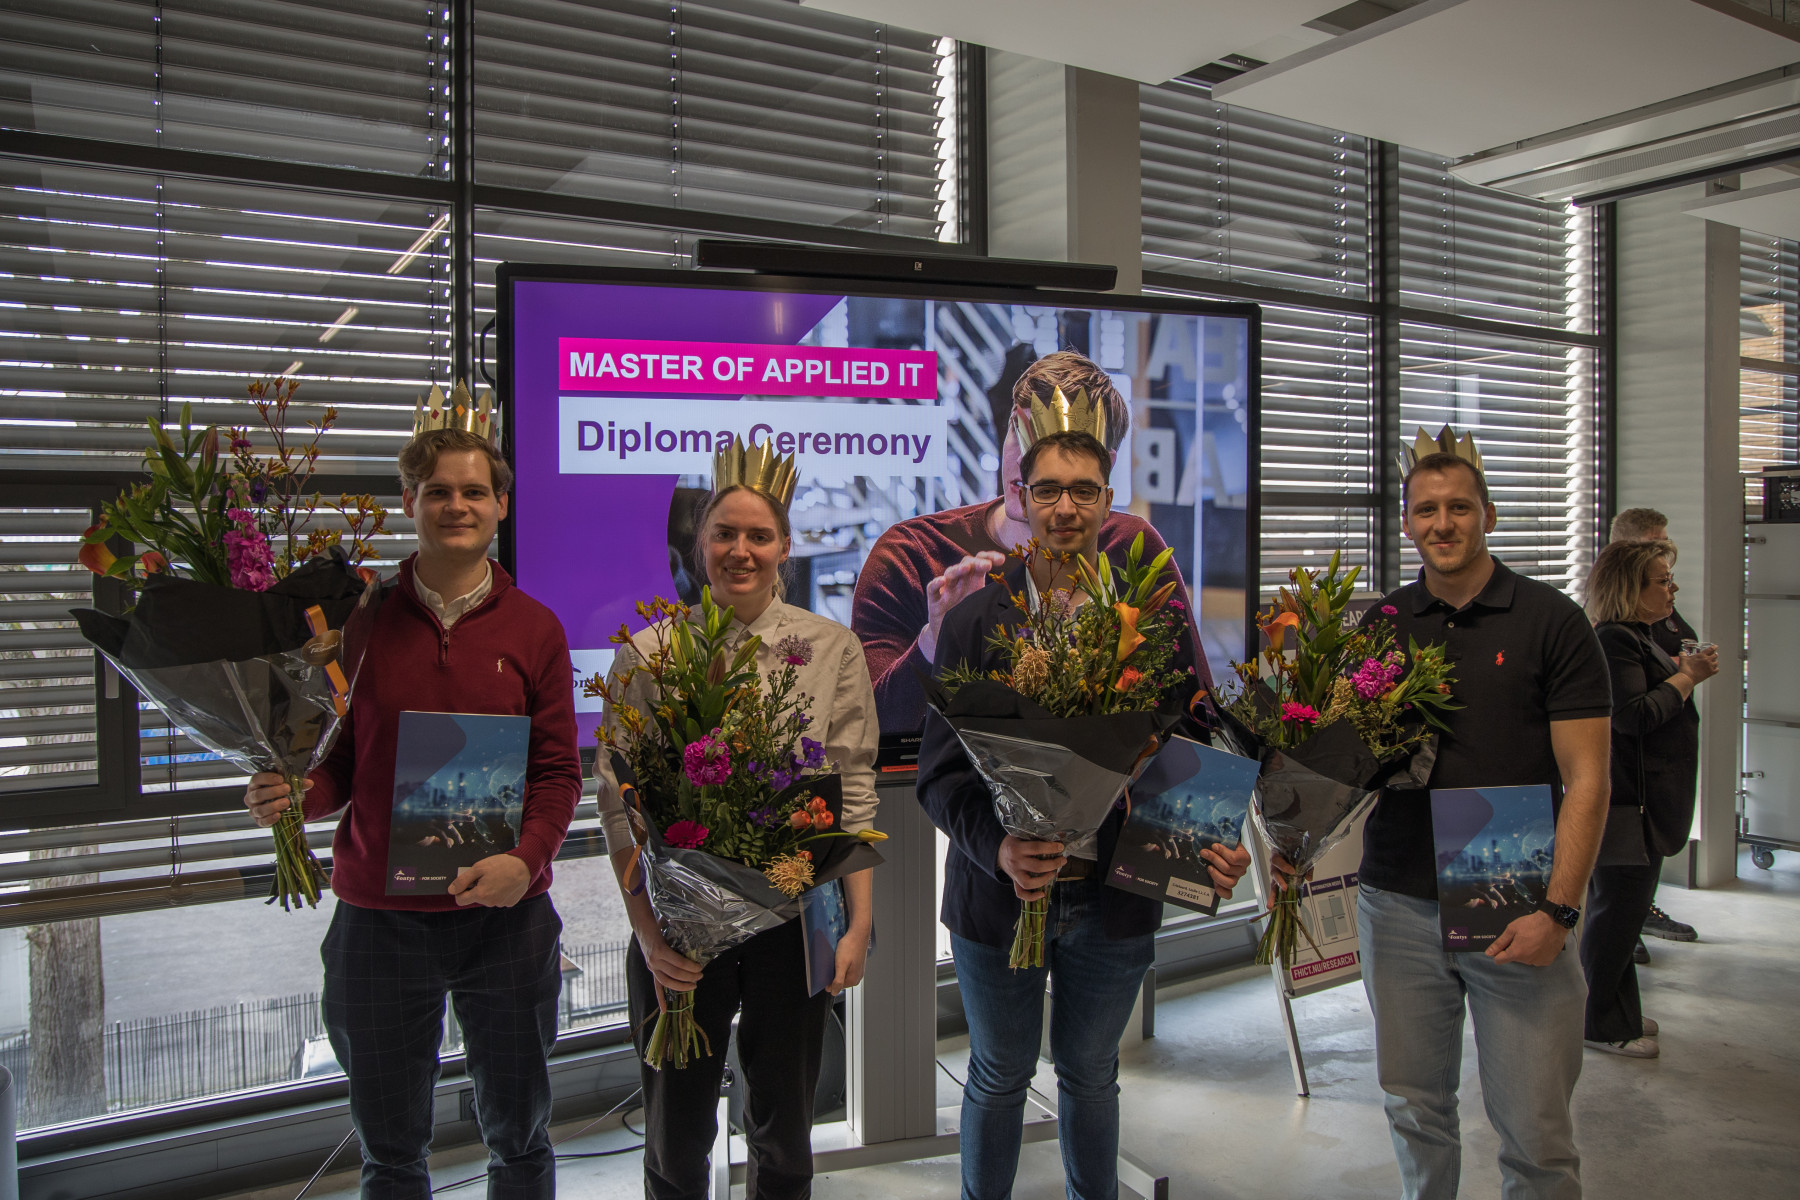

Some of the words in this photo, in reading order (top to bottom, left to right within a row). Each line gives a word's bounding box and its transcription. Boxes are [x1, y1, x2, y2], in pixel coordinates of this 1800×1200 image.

[569, 352, 704, 380] MASTER
[712, 356, 754, 381] OF
[762, 358, 890, 386] APPLIED
[899, 363, 924, 387] IT
[578, 420, 735, 460] Diploma
[748, 423, 932, 464] Ceremony
[1293, 954, 1354, 979] FHICT.NU/RESEARCH
